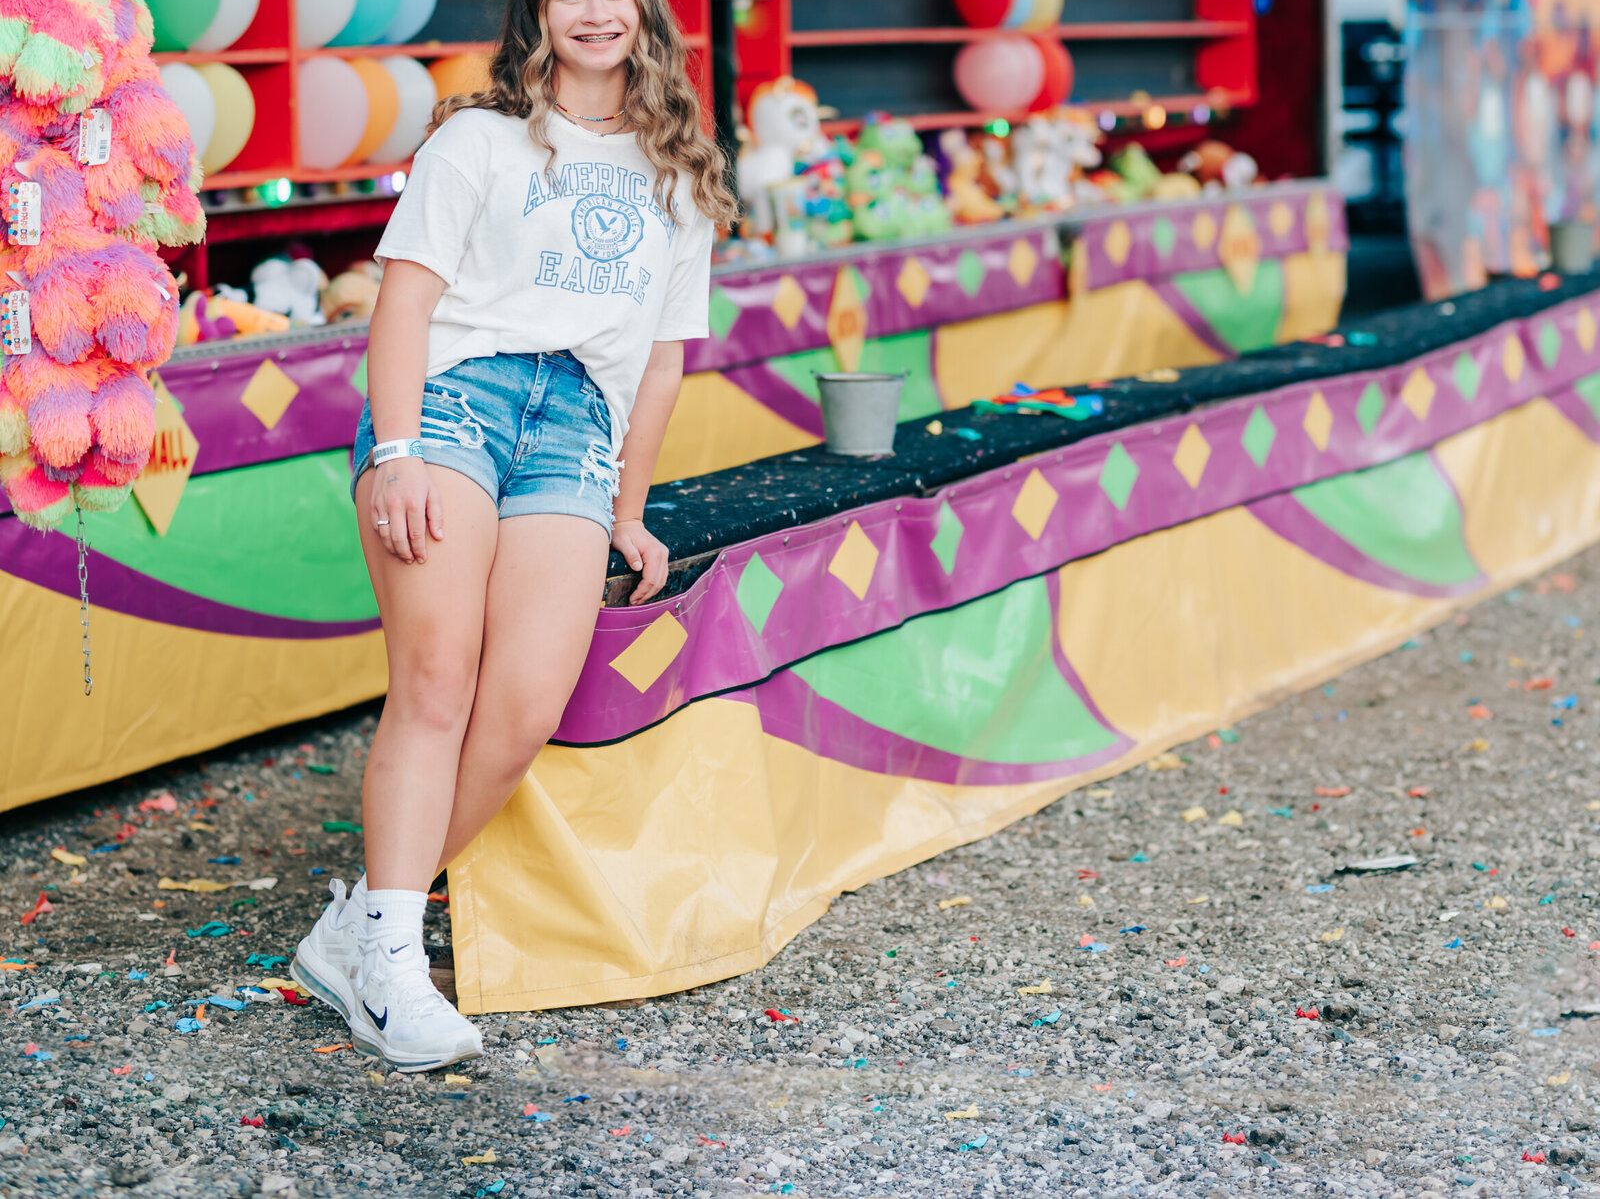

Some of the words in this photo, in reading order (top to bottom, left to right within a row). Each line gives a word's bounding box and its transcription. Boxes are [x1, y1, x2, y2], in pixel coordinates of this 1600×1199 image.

[523, 162, 679, 248] AMERICAN
[577, 198, 612, 220] AMERICAN
[617, 204, 640, 228] EAGLE
[534, 250, 651, 306] EAGLE
